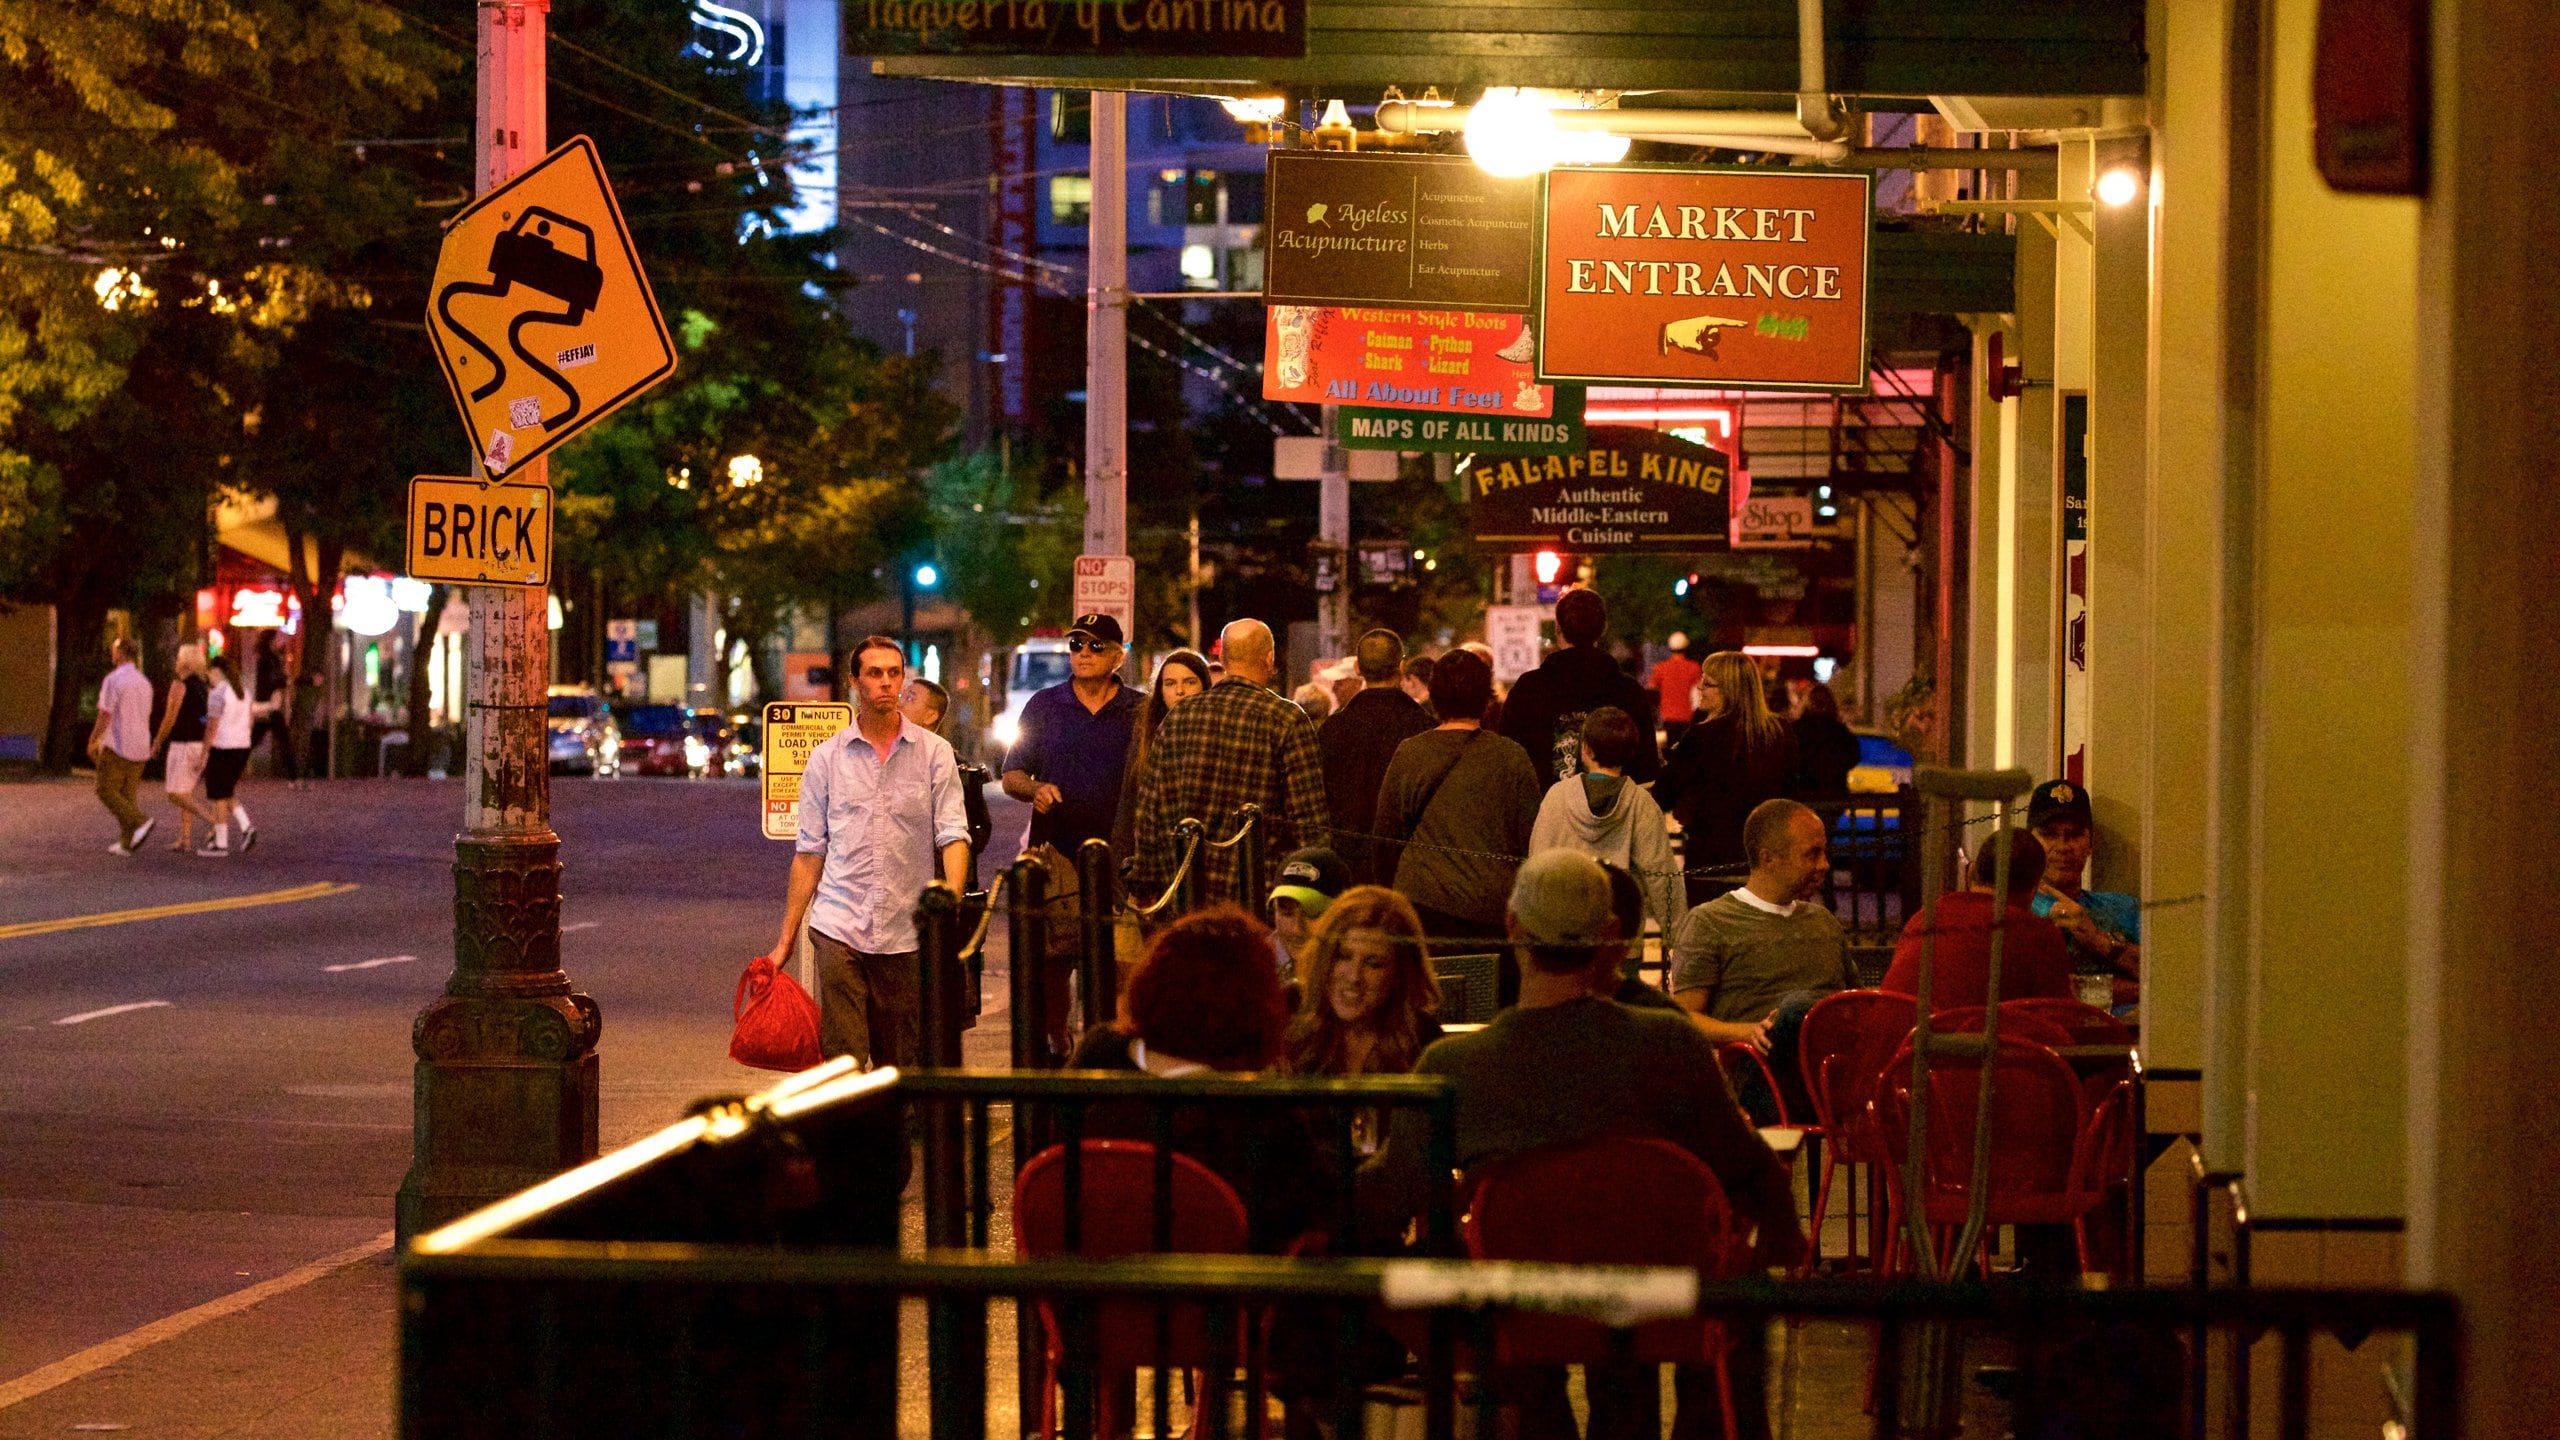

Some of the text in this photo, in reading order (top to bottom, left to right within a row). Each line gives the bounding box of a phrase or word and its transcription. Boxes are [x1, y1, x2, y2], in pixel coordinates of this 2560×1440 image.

[1421, 191, 1486, 204] Acupuncture
[1338, 201, 1408, 231] Ageless
[1420, 215, 1530, 230] Cosmetic Acupuncture
[1597, 204, 1816, 243] MARKET
[1278, 230, 1407, 259] Acupuncture
[1419, 239, 1449, 251] Herbs
[1418, 263, 1501, 278] Ear Acupuncture
[1566, 259, 1842, 300] ENTRANCE
[1340, 308, 1508, 331] Western Style Boots
[1365, 330, 1473, 354] Caiman Python
[558, 343, 594, 364] #EFFJAY
[1364, 351, 1471, 376] Shark Lizard
[1323, 379, 1505, 411] All About Feet
[1352, 418, 1570, 444] MAPS OF ALL KINDS
[1475, 449, 1725, 497] FALAFEL KING
[1557, 486, 1644, 504] Authentic
[1531, 506, 1669, 525] Middle-Eastern
[1741, 502, 1803, 535] Shop
[423, 501, 538, 564] BRICK
[1566, 527, 1634, 544] Cuisine
[1080, 560, 1101, 573] NO
[1080, 581, 1128, 595] STOPS
[772, 708, 790, 720] 30
[779, 739, 807, 748] LOAD
[771, 802, 787, 811] NO
